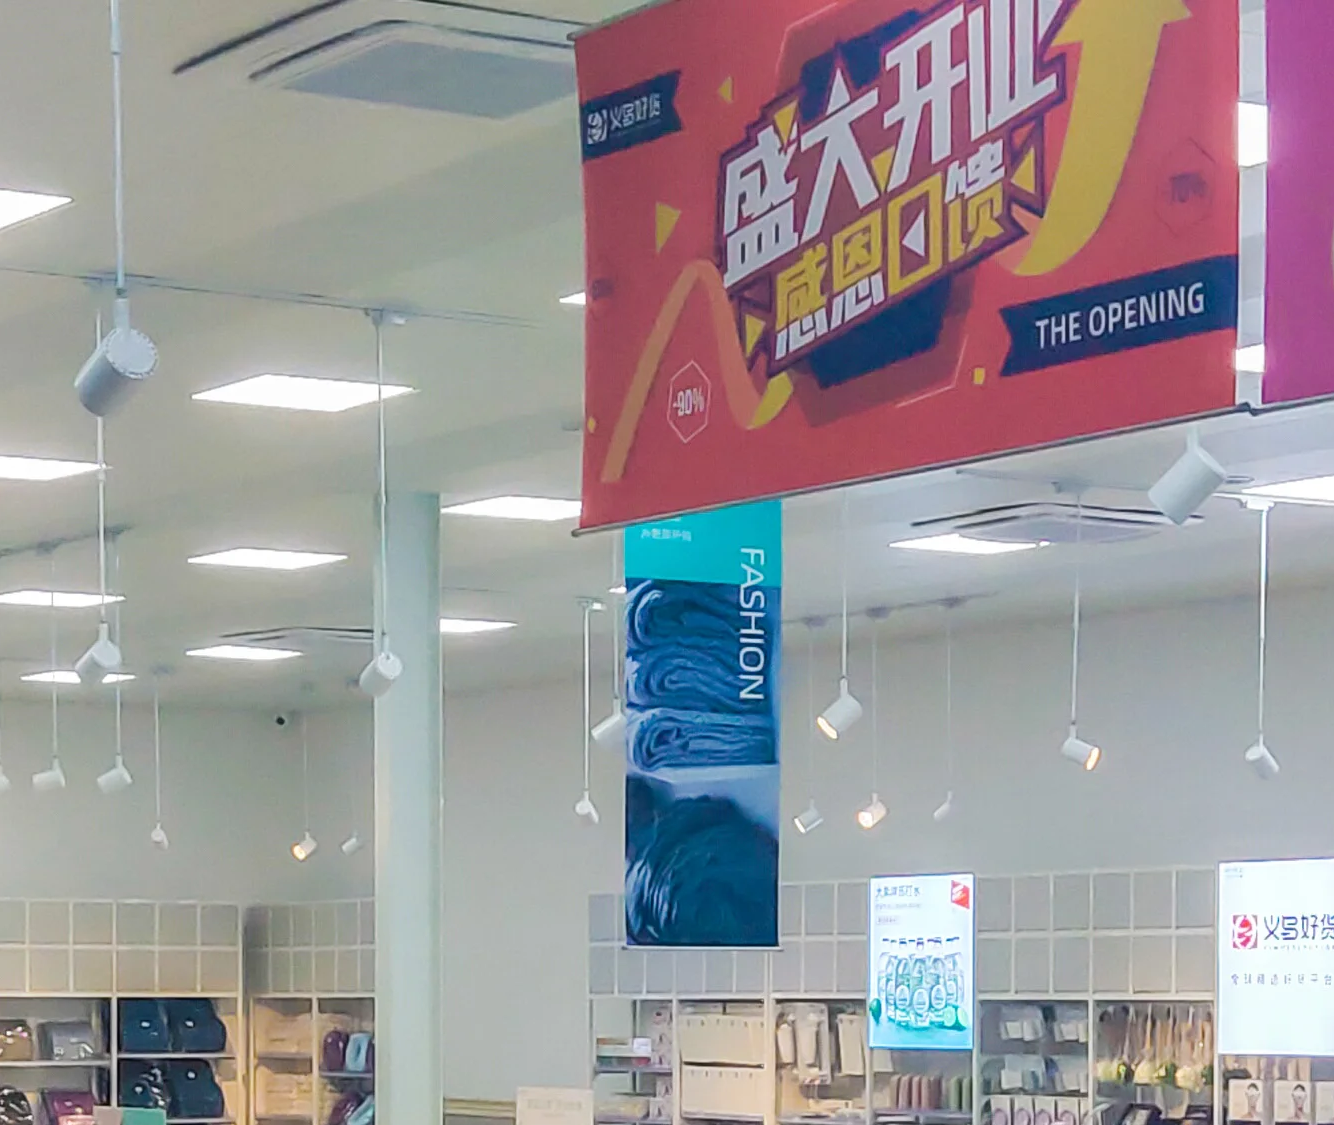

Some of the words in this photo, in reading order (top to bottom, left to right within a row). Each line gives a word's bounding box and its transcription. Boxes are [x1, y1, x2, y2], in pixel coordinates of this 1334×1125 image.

[723, 0, 1062, 288] 盛大开业
[1035, 311, 1082, 350] THE
[1088, 281, 1205, 337] OPENING
[739, 547, 765, 700] FASHION
